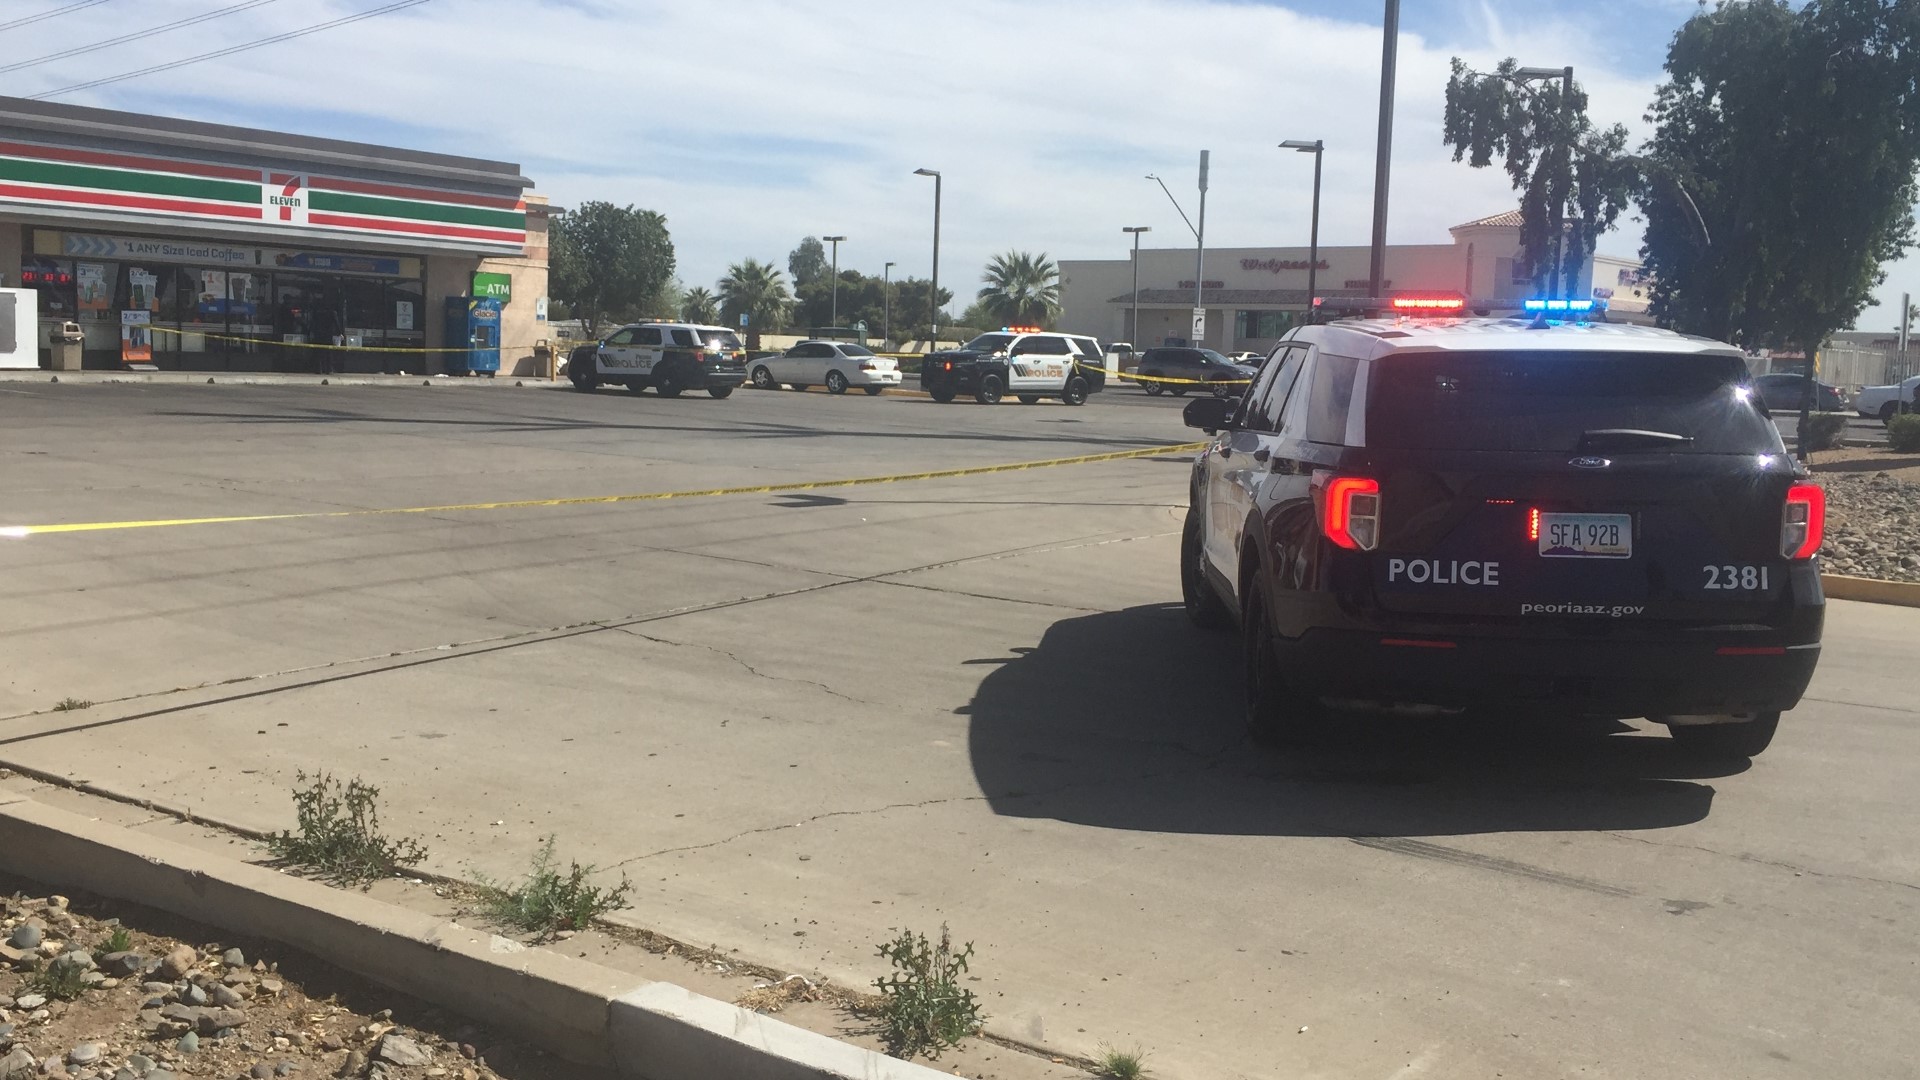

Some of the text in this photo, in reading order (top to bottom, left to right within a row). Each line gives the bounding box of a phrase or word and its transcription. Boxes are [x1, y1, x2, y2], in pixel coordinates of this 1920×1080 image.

[280, 174, 301, 221] 7
[136, 243, 160, 254] ANY
[162, 245, 184, 256] Size
[186, 247, 209, 257] Iced
[211, 248, 245, 262] Coffee
[486, 283, 510, 295] ATM
[613, 359, 652, 369] POLICE
[1027, 369, 1064, 378] POLICE
[1550, 523, 1619, 546] SFA 92B
[1388, 558, 1500, 586] POLICE
[1702, 564, 1769, 590] 2381
[1520, 601, 1645, 618] peoriaaz.gov
